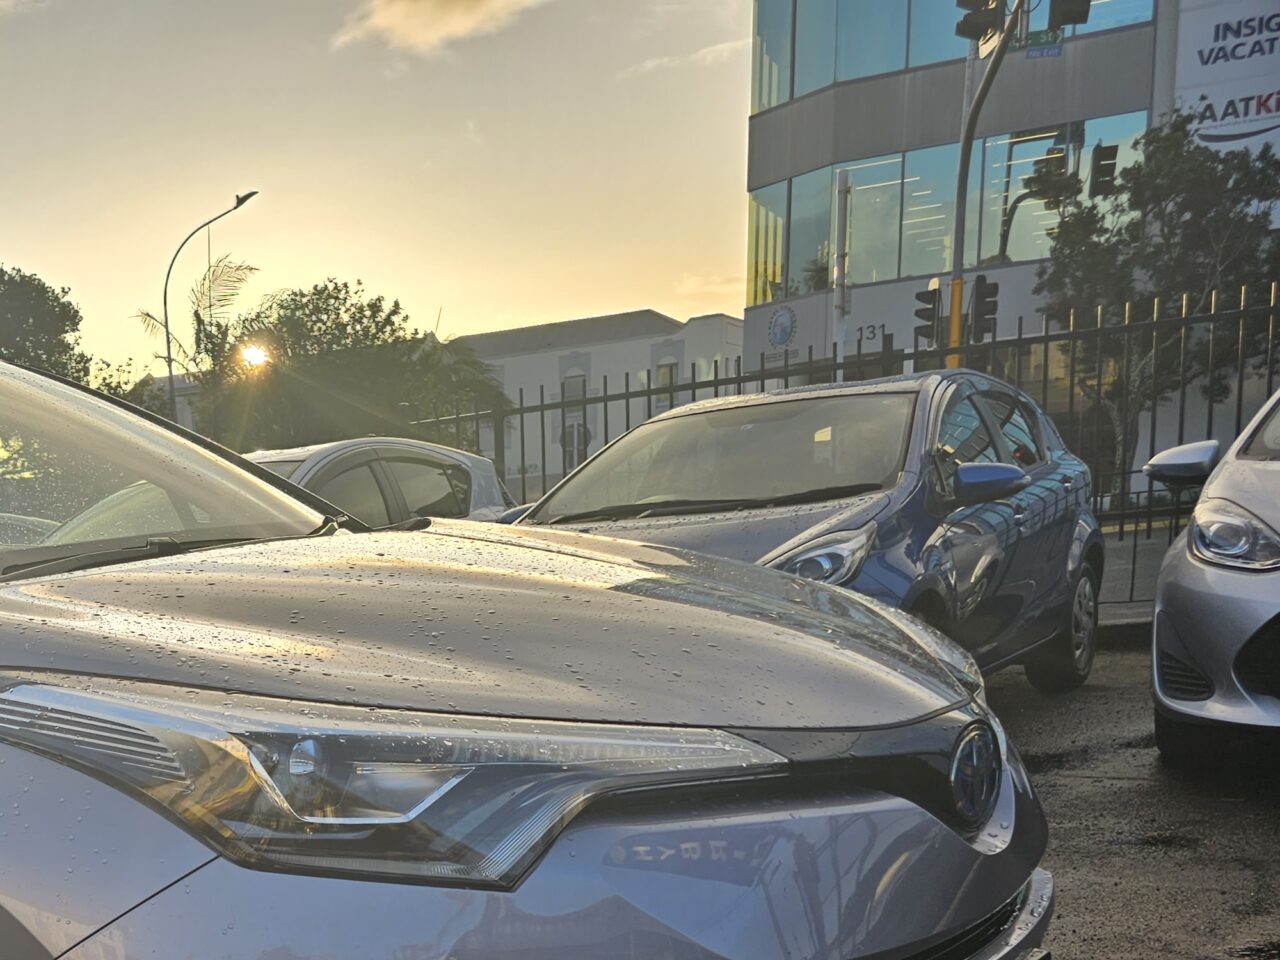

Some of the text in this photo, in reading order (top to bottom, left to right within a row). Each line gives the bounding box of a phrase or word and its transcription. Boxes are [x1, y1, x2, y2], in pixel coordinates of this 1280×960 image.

[1213, 13, 1280, 43] INSIG
[1197, 37, 1280, 66] VACAT
[856, 323, 886, 340] 131
